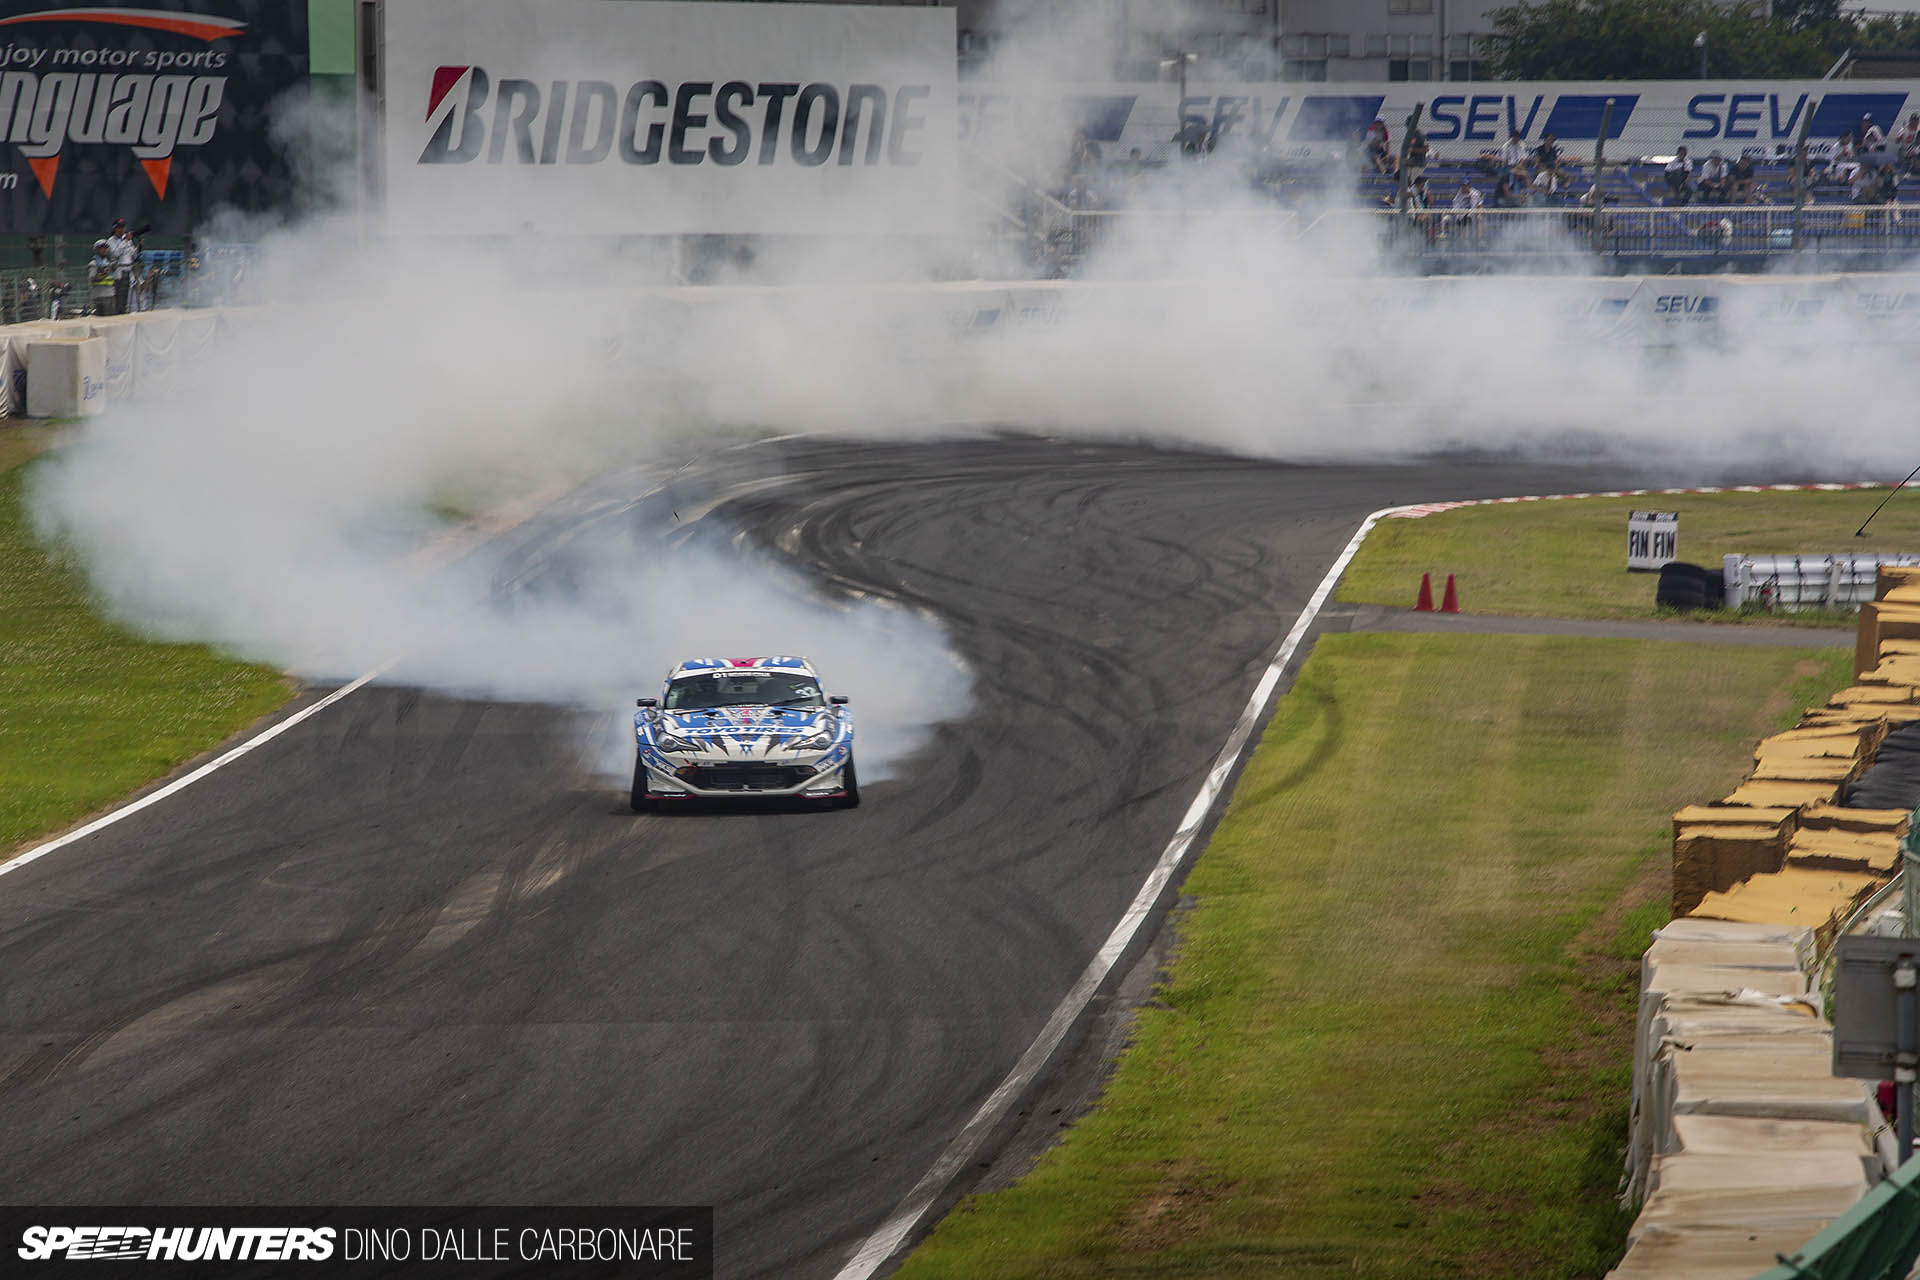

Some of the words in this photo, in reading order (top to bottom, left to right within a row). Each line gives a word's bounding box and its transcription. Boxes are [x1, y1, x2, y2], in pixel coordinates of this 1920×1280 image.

[52, 47, 139, 66] motor
[144, 50, 228, 71] sports
[0, 71, 229, 160] nguage
[417, 65, 930, 167] BRIDGESTONE
[1426, 95, 1545, 140] SEV
[1682, 92, 1809, 139] SEV
[1655, 295, 1699, 313] SEV
